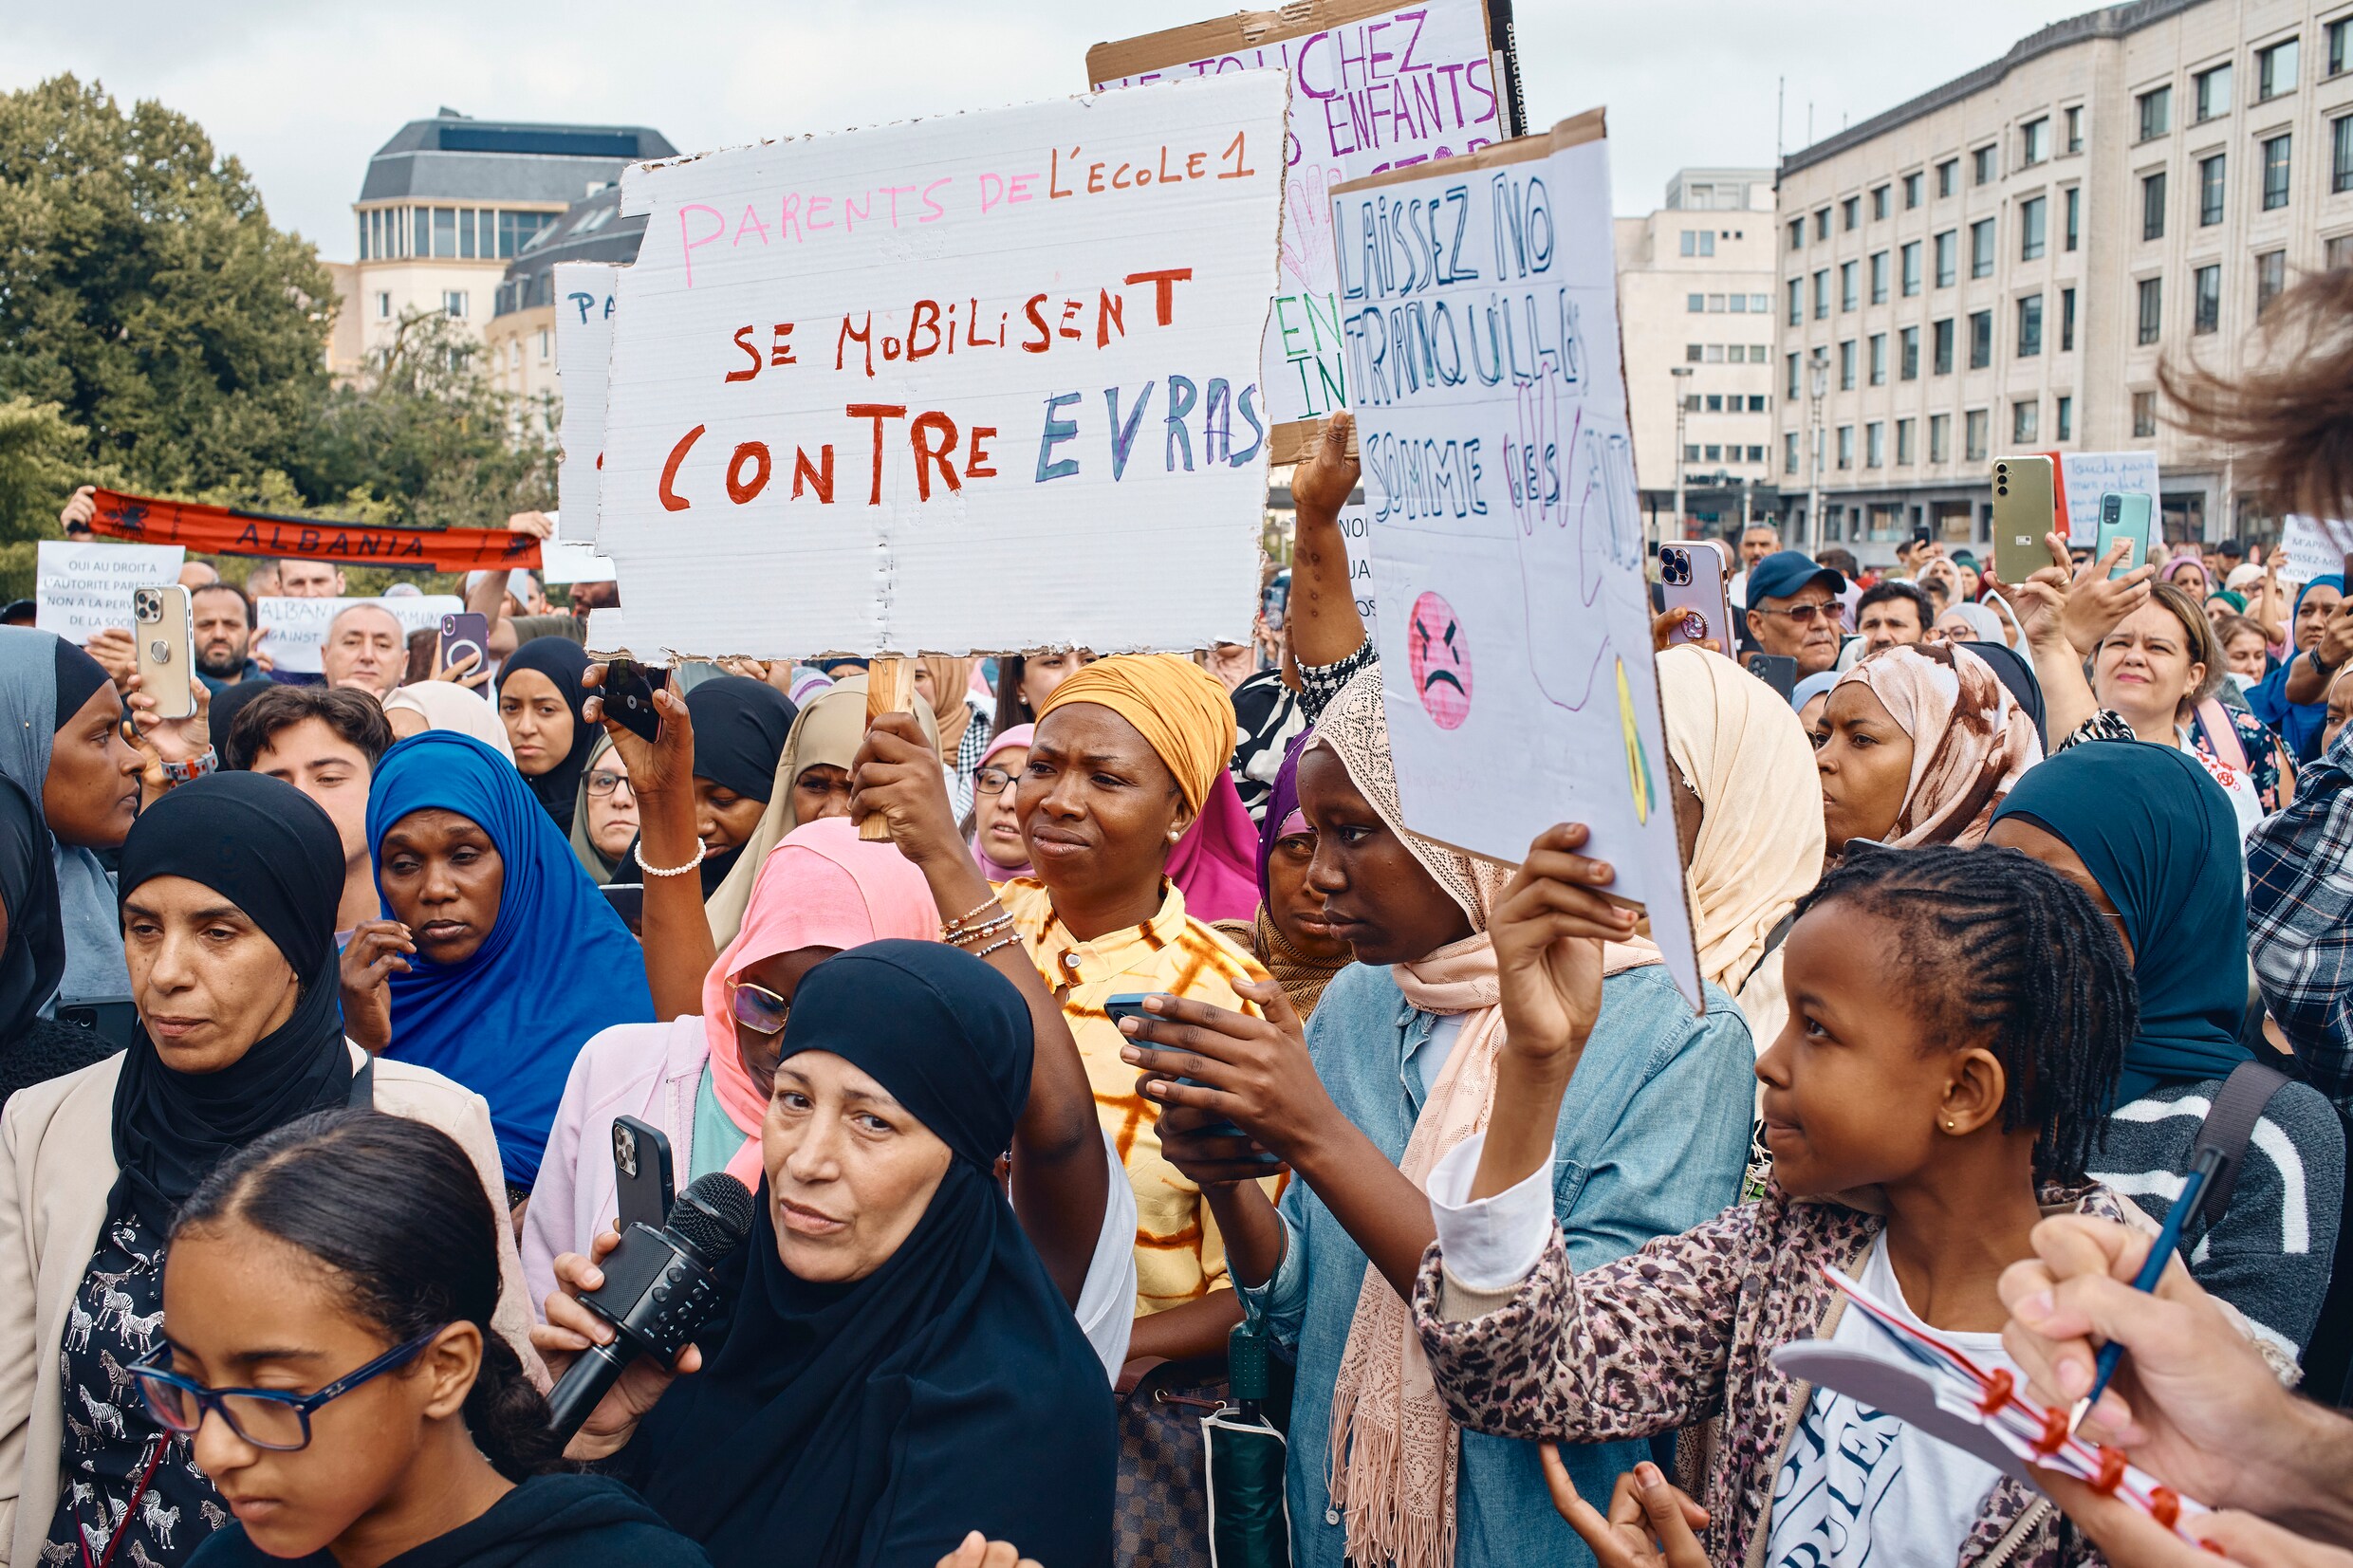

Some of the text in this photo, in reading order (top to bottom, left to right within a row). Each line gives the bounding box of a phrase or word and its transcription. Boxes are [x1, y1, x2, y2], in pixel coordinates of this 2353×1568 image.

[1325, 58, 1496, 157] ENFANTS
[680, 178, 952, 289] PARENTS
[980, 173, 1042, 216] DE
[725, 323, 798, 383] SE
[658, 375, 1264, 512] CONTRE EVRAS
[1367, 432, 1488, 524] SOMME
[236, 524, 423, 558] ALBANIA
[44, 578, 109, 590] L'AUTORITE
[69, 561, 90, 570] OUI
[94, 562, 110, 572] AU
[113, 563, 146, 573] DROIT
[47, 597, 74, 607] NON
[89, 599, 102, 608] LA
[69, 616, 85, 626] DE
[88, 617, 102, 626] LA
